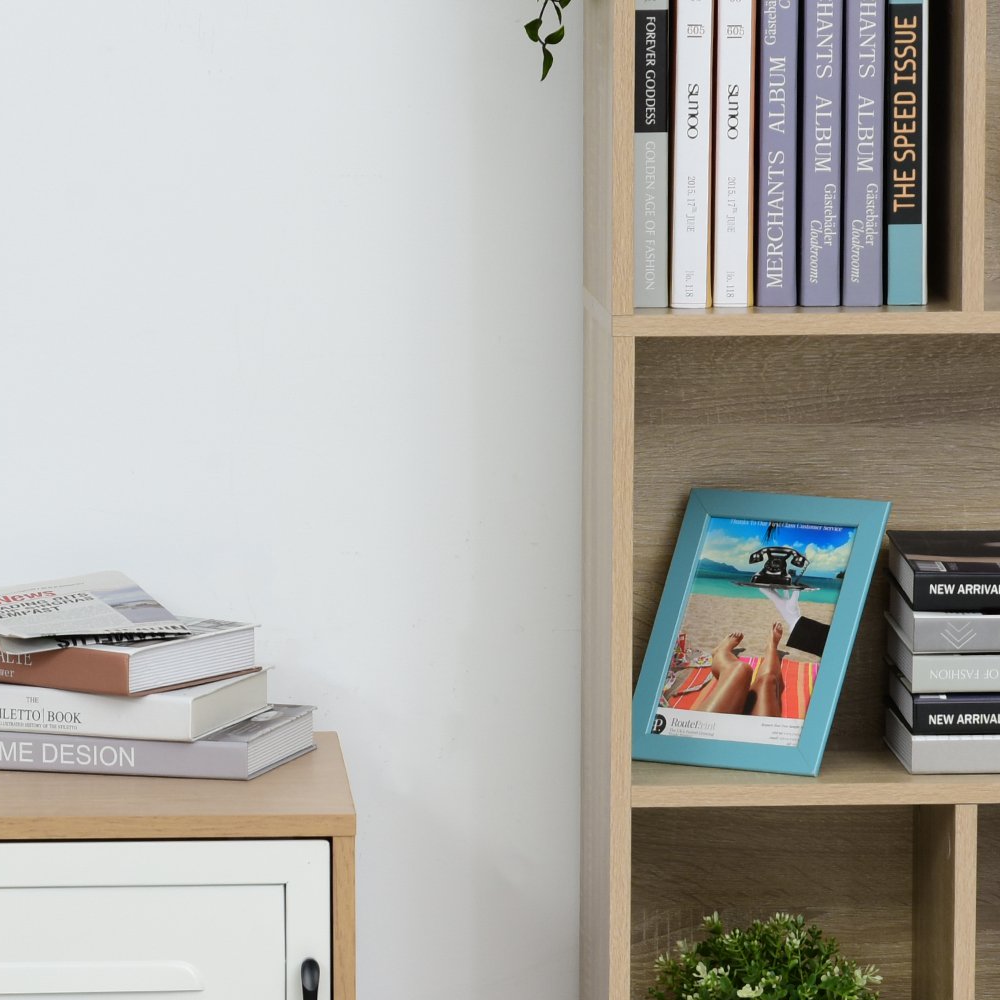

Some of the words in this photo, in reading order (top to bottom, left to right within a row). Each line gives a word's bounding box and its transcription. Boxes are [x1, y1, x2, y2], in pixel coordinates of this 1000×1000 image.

[645, 16, 657, 67] FOREVER
[893, 15, 917, 85] ISSUE
[645, 70, 656, 126] GODDESS
[768, 56, 787, 134] ALBUM
[814, 95, 833, 173] ALBUM
[856, 95, 875, 173] ALBUM
[893, 91, 917, 162] SPEED
[645, 141, 656, 190] GOLDEN
[893, 168, 916, 213] THE
[645, 193, 656, 217] AGE
[645, 220, 656, 235] OF
[766, 150, 785, 288] MERCHANTS
[823, 183, 837, 247] Gästebäder
[865, 183, 879, 246] Gästebäder
[645, 239, 656, 290] FASHION
[809, 219, 823, 284] Cloakrooms
[850, 219, 865, 284] Cloakrooms
[929, 583, 956, 595] NEW
[25, 696, 40, 704] THE
[929, 669, 980, 680] FASHION
[983, 669, 999, 680] OF
[47, 710, 82, 724] BOOK
[928, 714, 955, 725] NEW
